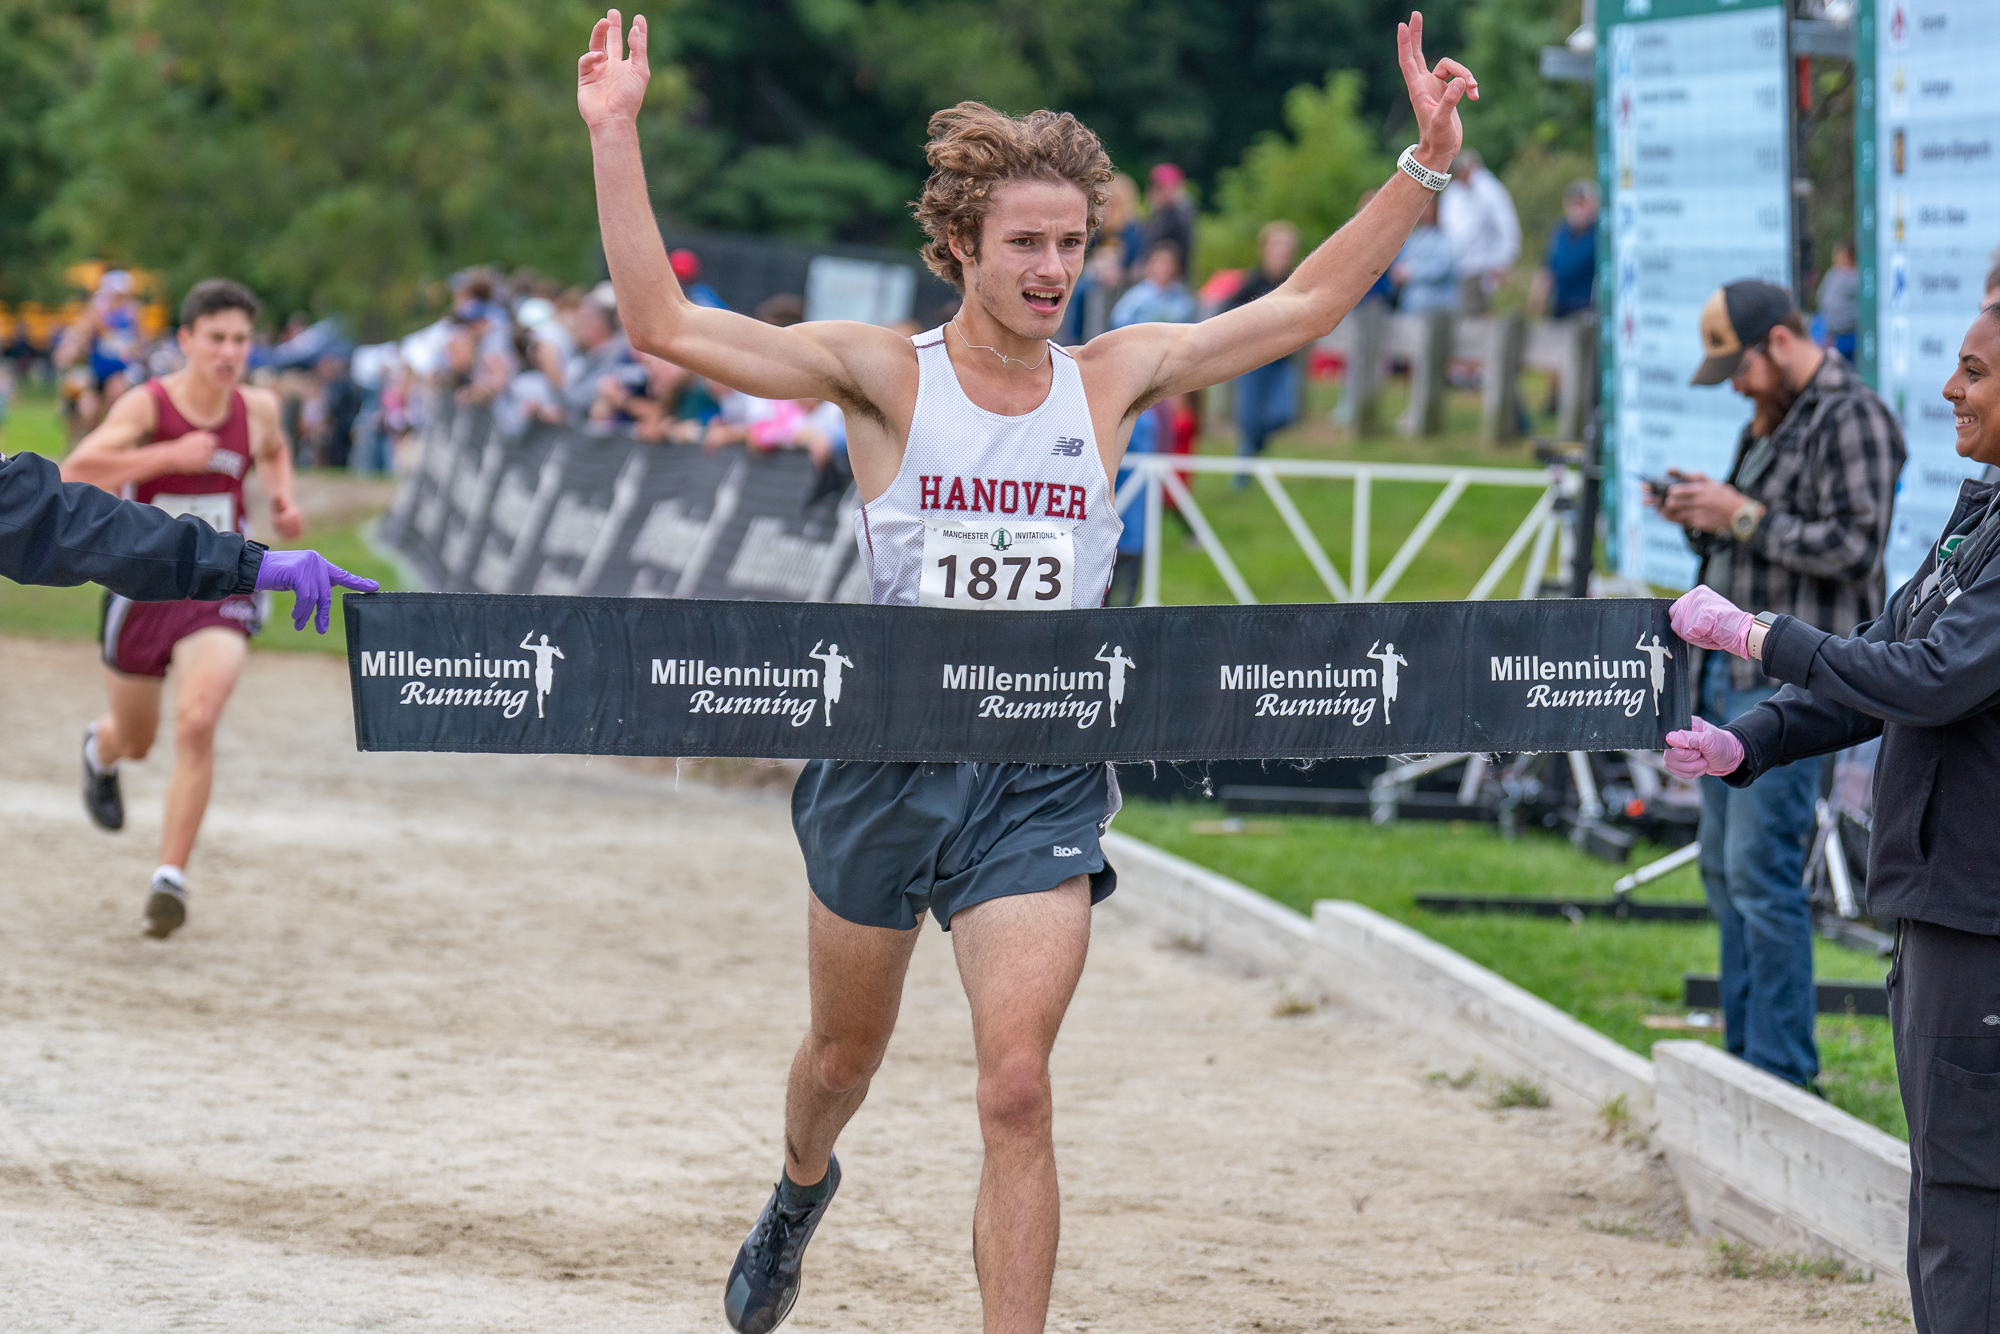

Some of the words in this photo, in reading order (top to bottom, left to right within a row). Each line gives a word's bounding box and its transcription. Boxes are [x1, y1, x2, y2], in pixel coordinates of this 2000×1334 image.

[919, 475, 1087, 520] HANOVER
[942, 529, 989, 540] MANCHESTER
[1015, 531, 1058, 540] INVITATIONAL
[937, 554, 1062, 601] 1873
[361, 650, 530, 679] Millennium
[651, 658, 819, 688] Millennium
[942, 664, 1104, 692] Millennium
[1220, 664, 1377, 690] Millennium
[1490, 654, 1646, 681] Millennium
[399, 680, 529, 719] Running
[688, 689, 817, 727] Running
[977, 692, 1103, 729] Running
[1254, 689, 1377, 727] Running
[1526, 680, 1647, 718] Running
